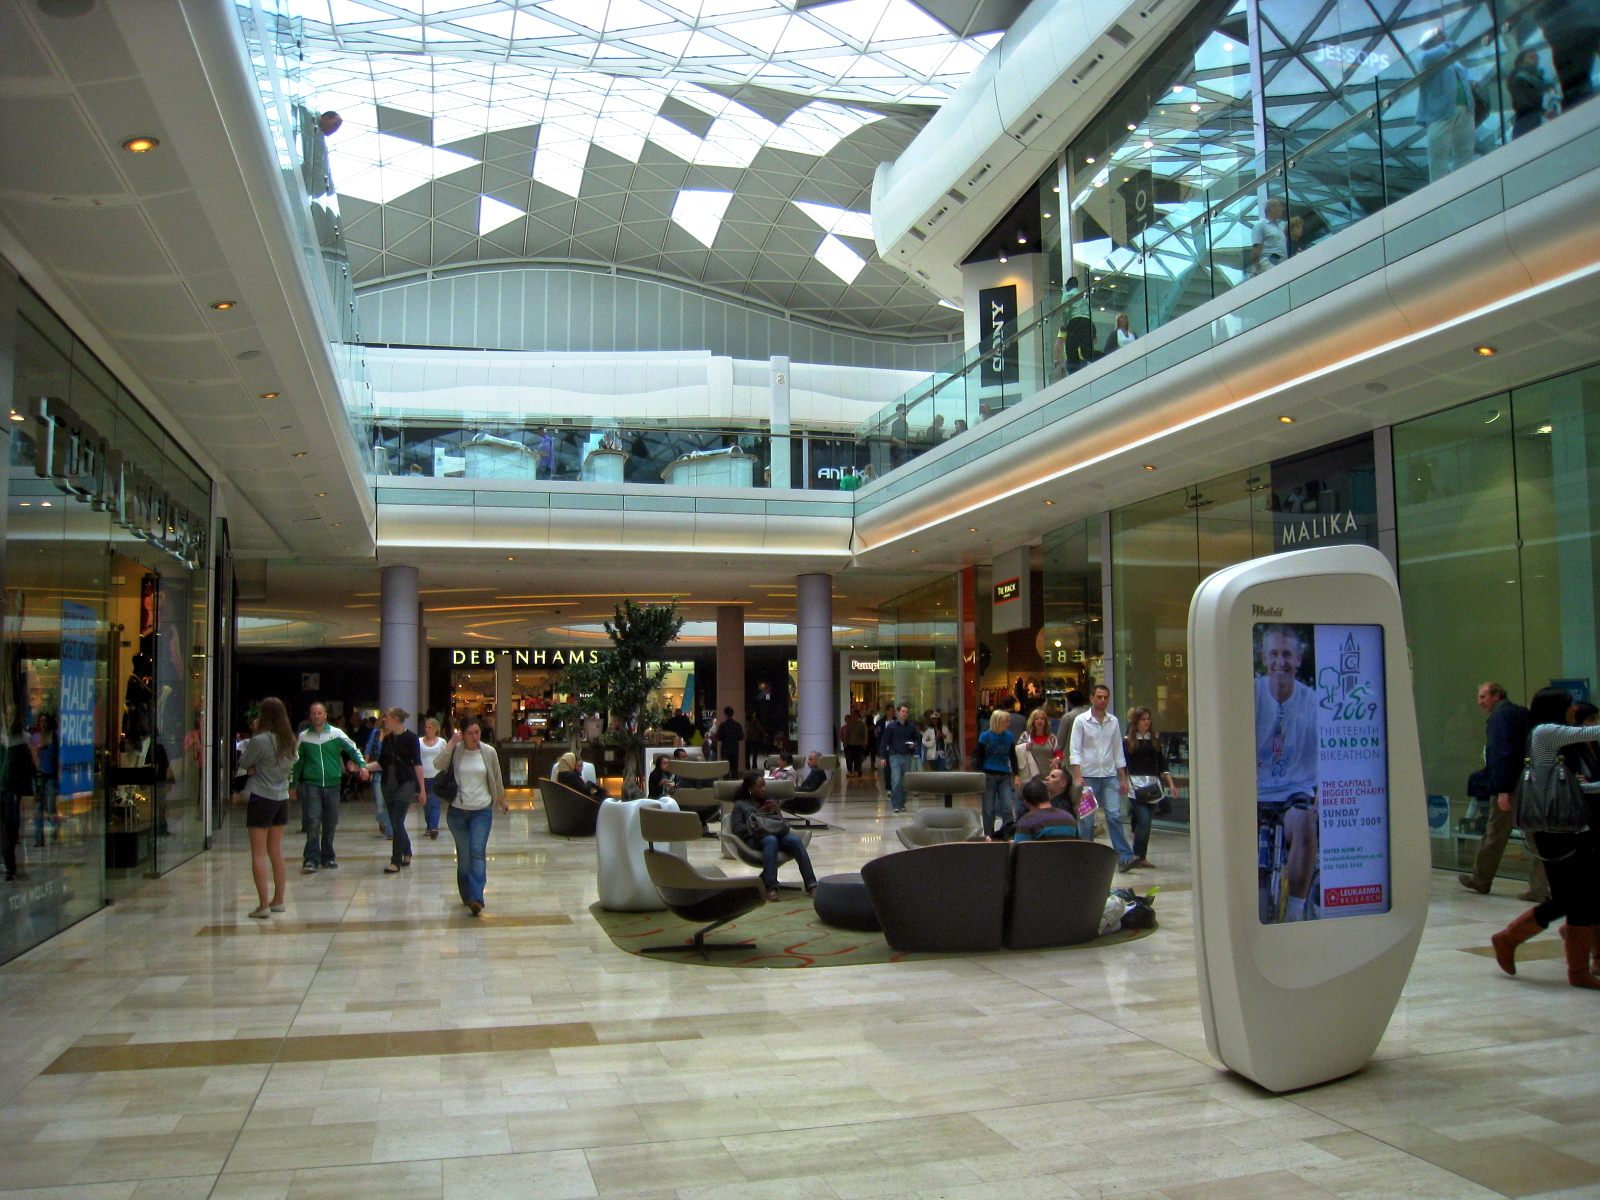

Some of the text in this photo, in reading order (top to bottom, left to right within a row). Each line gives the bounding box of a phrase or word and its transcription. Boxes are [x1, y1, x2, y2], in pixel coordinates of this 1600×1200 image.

[1313, 44, 1390, 70] JESSOPS
[1282, 510, 1357, 545] MALIKA
[61, 675, 94, 712] HALF
[1332, 702, 1377, 721] 2009
[60, 714, 94, 747] PRICE
[1319, 726, 1379, 736] THIRTEENTH
[1320, 737, 1379, 748] LONDON
[1320, 749, 1380, 761] BIKEATHON
[1322, 779, 1372, 789] THE CAPITAL'S
[1322, 787, 1385, 797] BIGGEST CHARITY
[1323, 797, 1357, 806] BIKE RIDE
[1323, 808, 1360, 818] SUNDAY
[1323, 816, 1382, 829] 19 JULY 2009
[1340, 886, 1380, 897] LEUKAEMIA
[1340, 895, 1381, 904] RESEARCH
